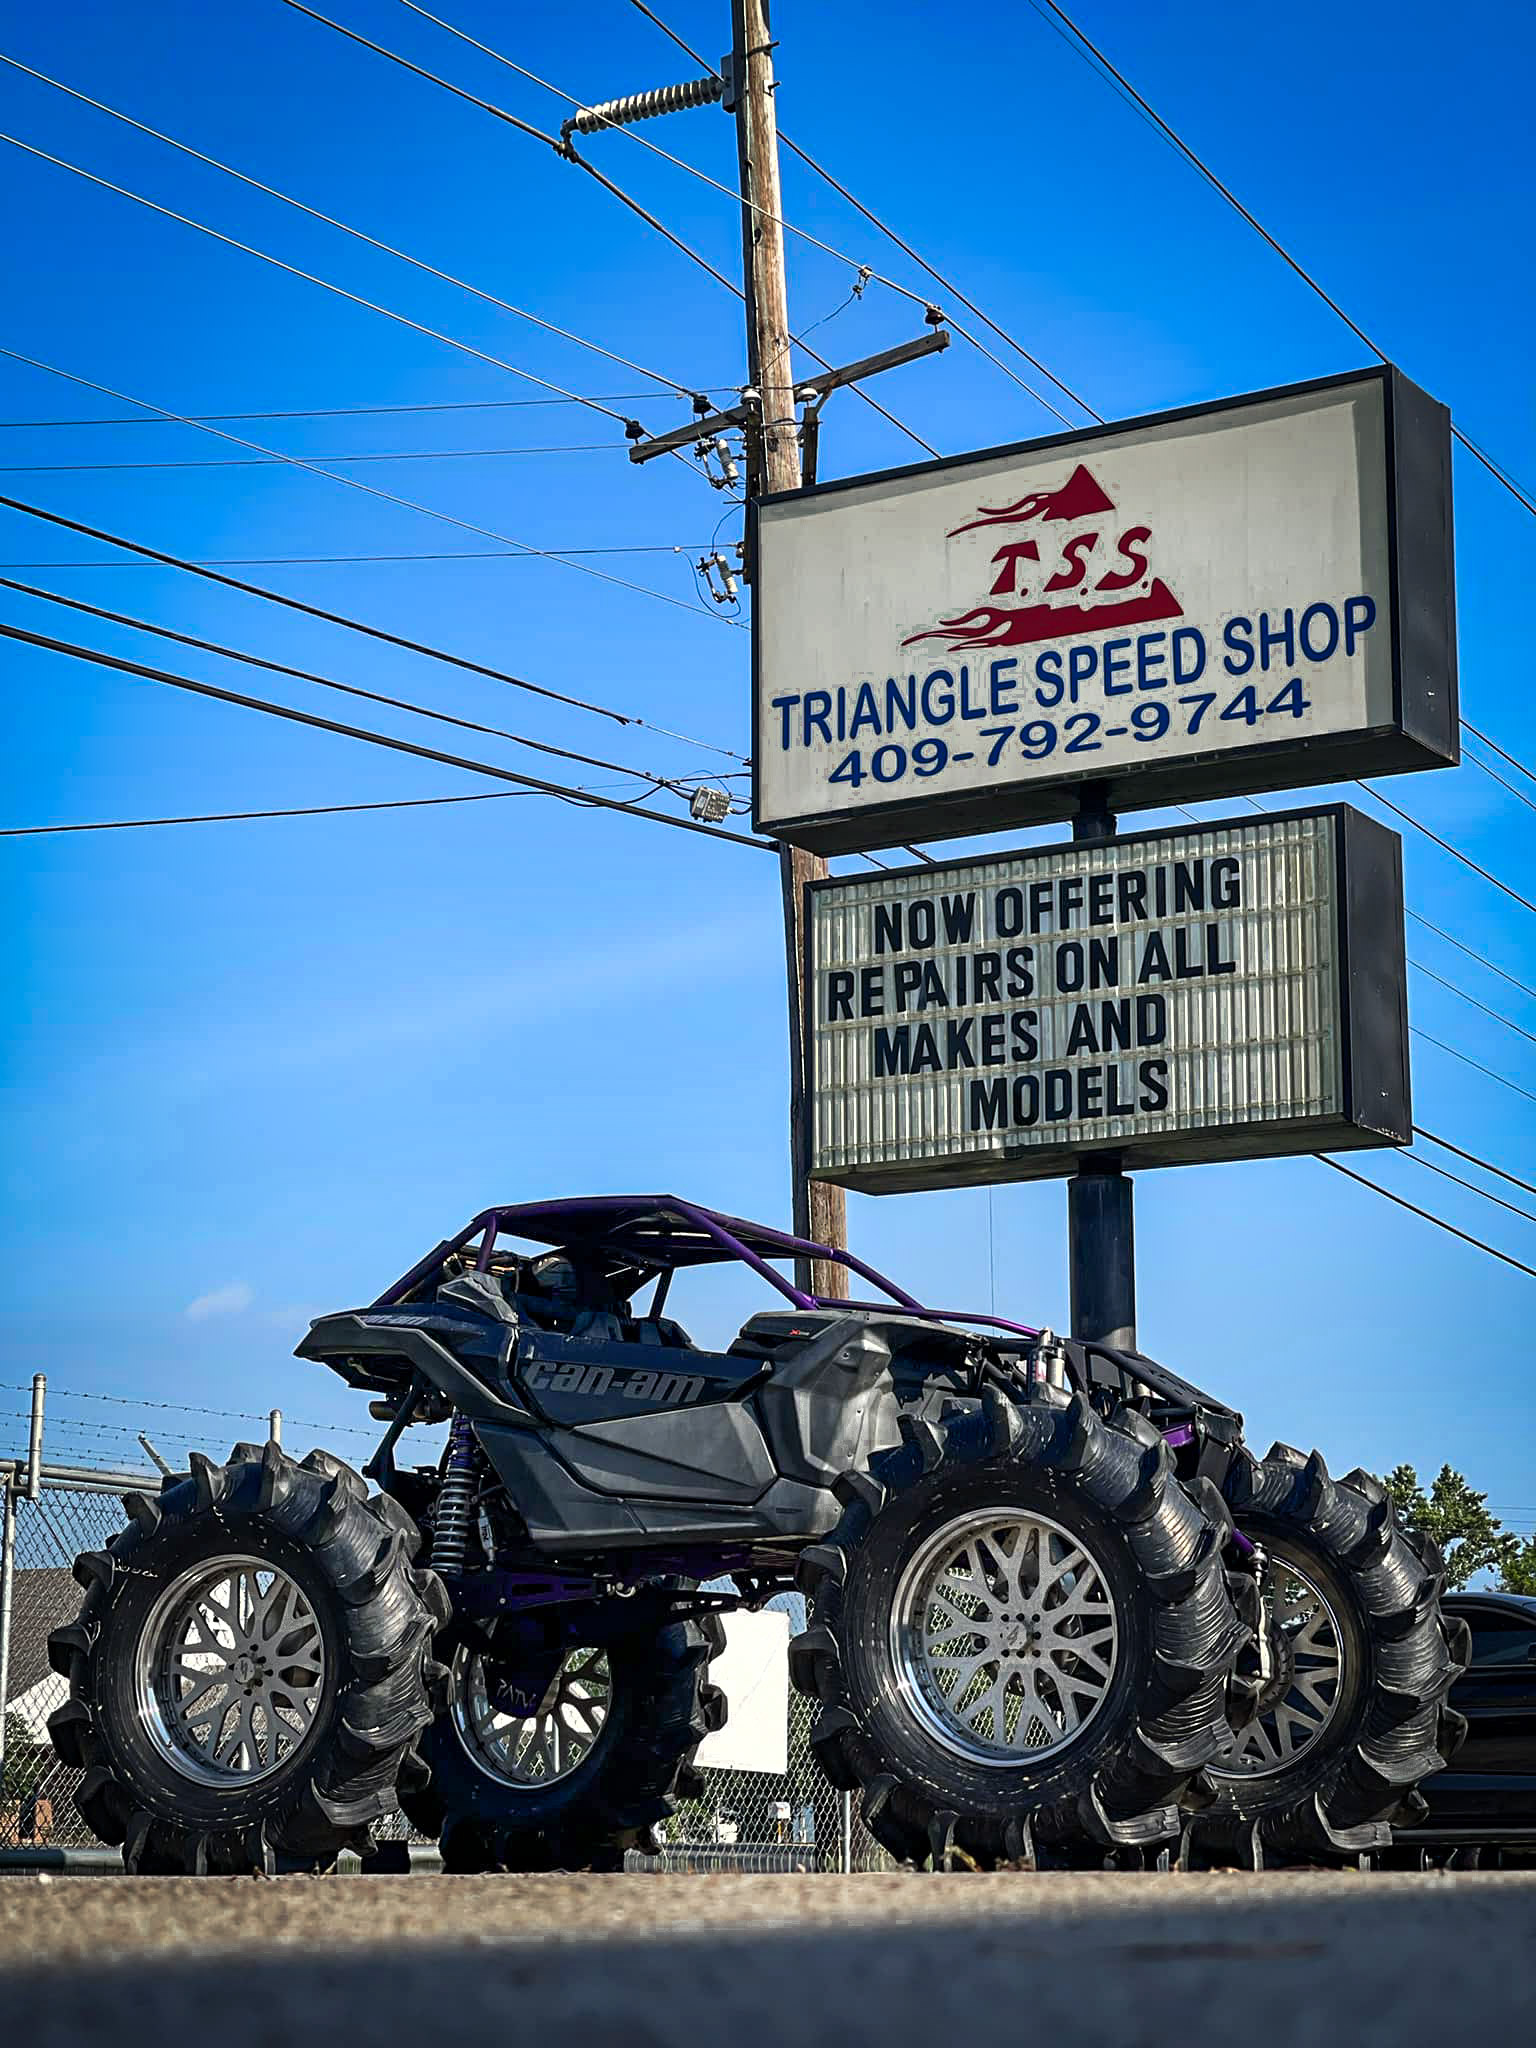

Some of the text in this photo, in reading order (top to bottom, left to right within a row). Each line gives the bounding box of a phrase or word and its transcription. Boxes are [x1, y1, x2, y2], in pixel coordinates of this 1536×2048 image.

[772, 597, 1377, 749] TRIANGLE SPEED SHOP
[829, 679, 1310, 787] 409-792-9744
[874, 857, 1241, 955] NOW OFFERING
[1056, 935, 1119, 994] ON
[1137, 922, 1236, 984] ALL
[874, 993, 1167, 1078] MAKES AND
[970, 1058, 1169, 1132] MODELS
[524, 1360, 706, 1403] can-am
